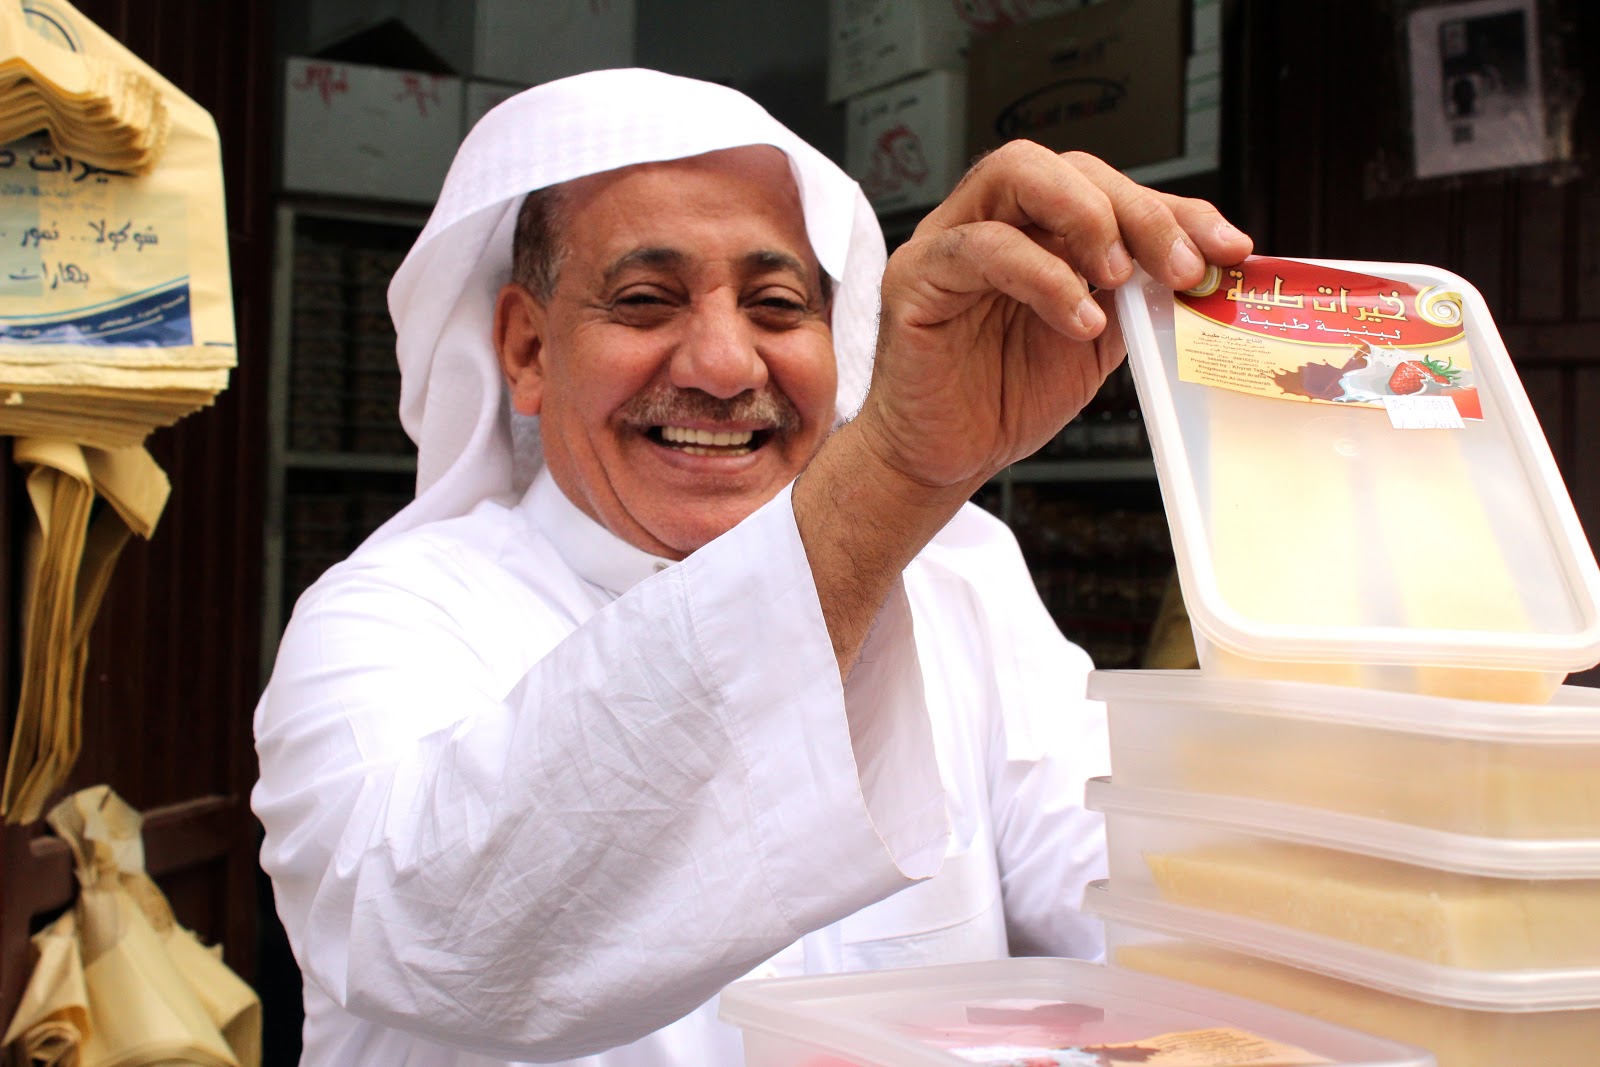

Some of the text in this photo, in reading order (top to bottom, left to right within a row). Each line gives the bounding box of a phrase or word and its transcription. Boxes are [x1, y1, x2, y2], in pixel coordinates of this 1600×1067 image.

[29, 150, 139, 183] يرات
[1225, 270, 1409, 323] خيرات طيبة
[1239, 312, 1402, 341] لبنية طيبة
[1191, 357, 1218, 367] Produced
